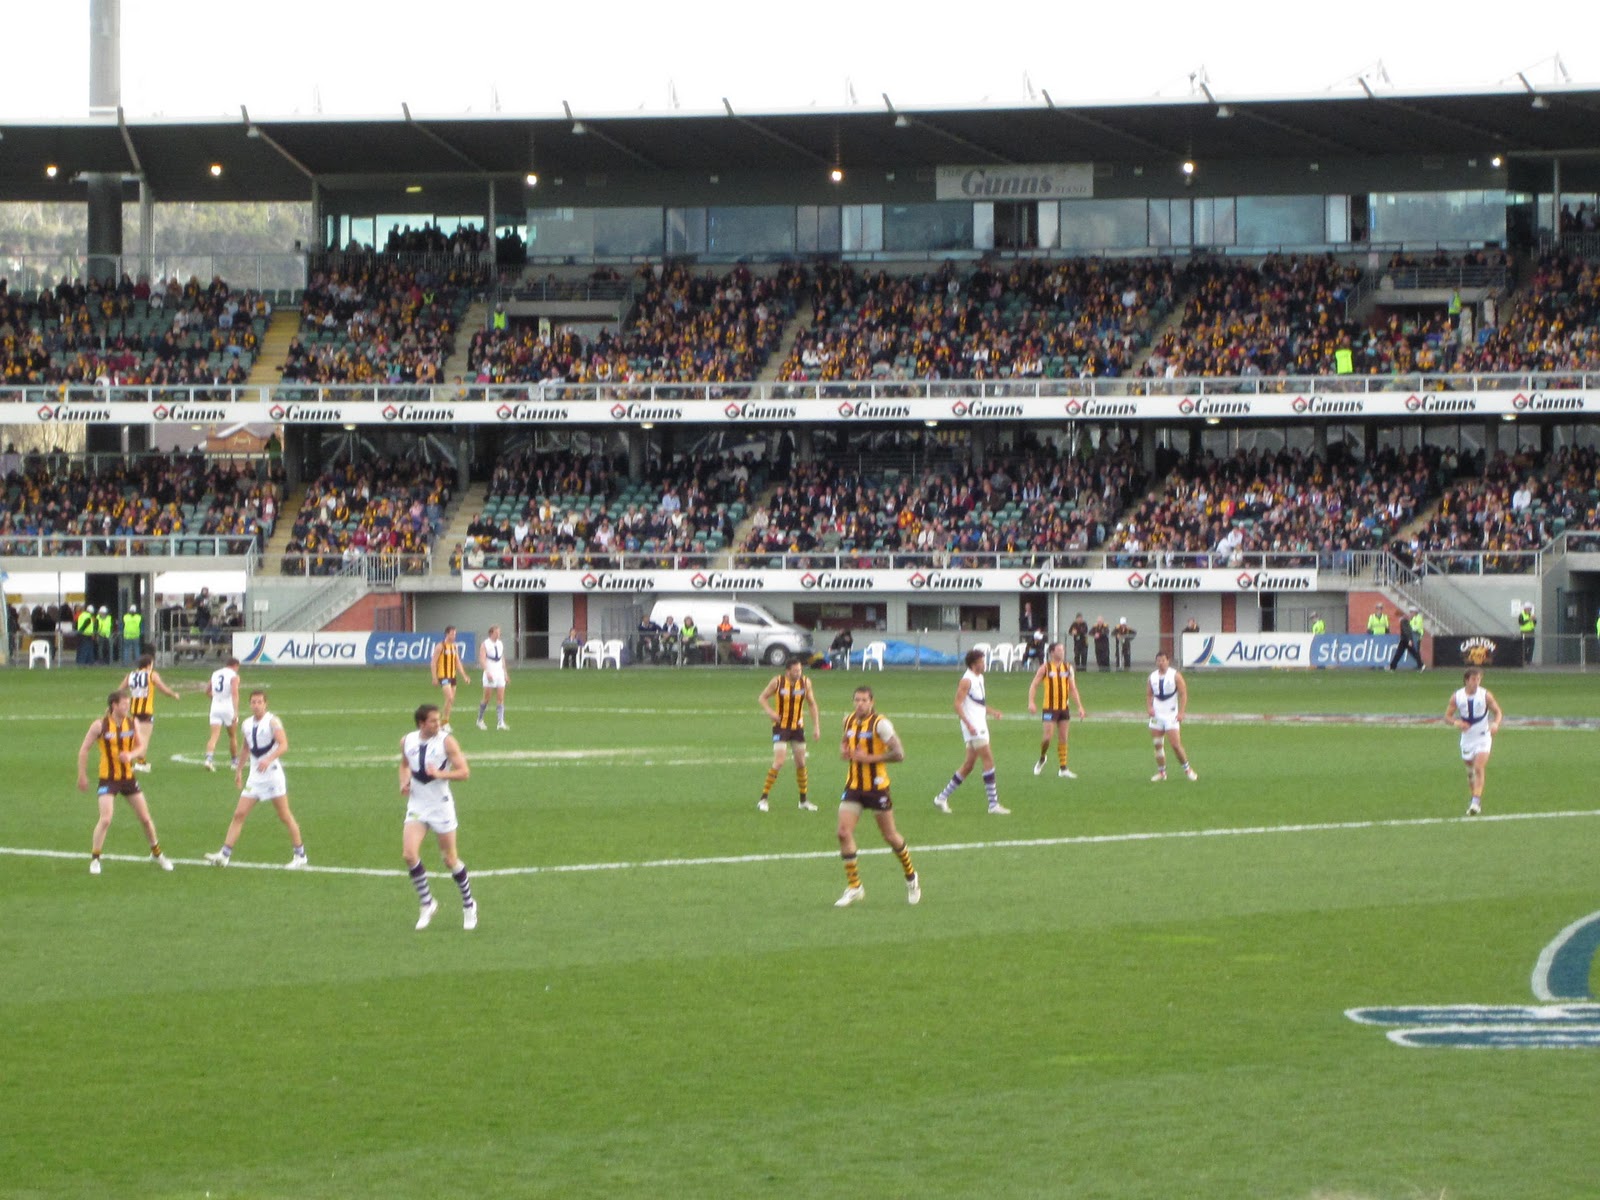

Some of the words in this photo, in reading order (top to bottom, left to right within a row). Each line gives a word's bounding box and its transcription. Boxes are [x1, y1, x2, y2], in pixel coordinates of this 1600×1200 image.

[961, 169, 1053, 196] Gunns
[740, 402, 796, 419] Gunns
[854, 402, 910, 419] Gunns
[967, 401, 1024, 418] Gunns
[1081, 400, 1137, 417] Gunns
[1194, 398, 1250, 414] Gunns
[1308, 397, 1364, 414] Gunns
[1421, 395, 1476, 412] Gunns
[1528, 394, 1584, 411] Gunns
[54, 405, 110, 421] Gunns
[169, 404, 225, 421] Gunns
[285, 404, 341, 421] Gunns
[398, 404, 454, 421] Gunns
[512, 404, 568, 421] Gunns
[626, 403, 682, 420] Gunns
[489, 573, 547, 590] Gunns
[707, 573, 764, 590] Gunns
[816, 573, 873, 590] Gunns
[926, 572, 983, 590] Gunns
[1035, 572, 1092, 590] Gunns
[1144, 572, 1201, 590] Gunns
[1253, 572, 1310, 590] Gunns
[277, 639, 356, 660] Aurora
[1226, 641, 1301, 661] Aurora
[1460, 636, 1497, 653] CARLTON
[131, 671, 149, 688] 30
[214, 674, 225, 692] 3
